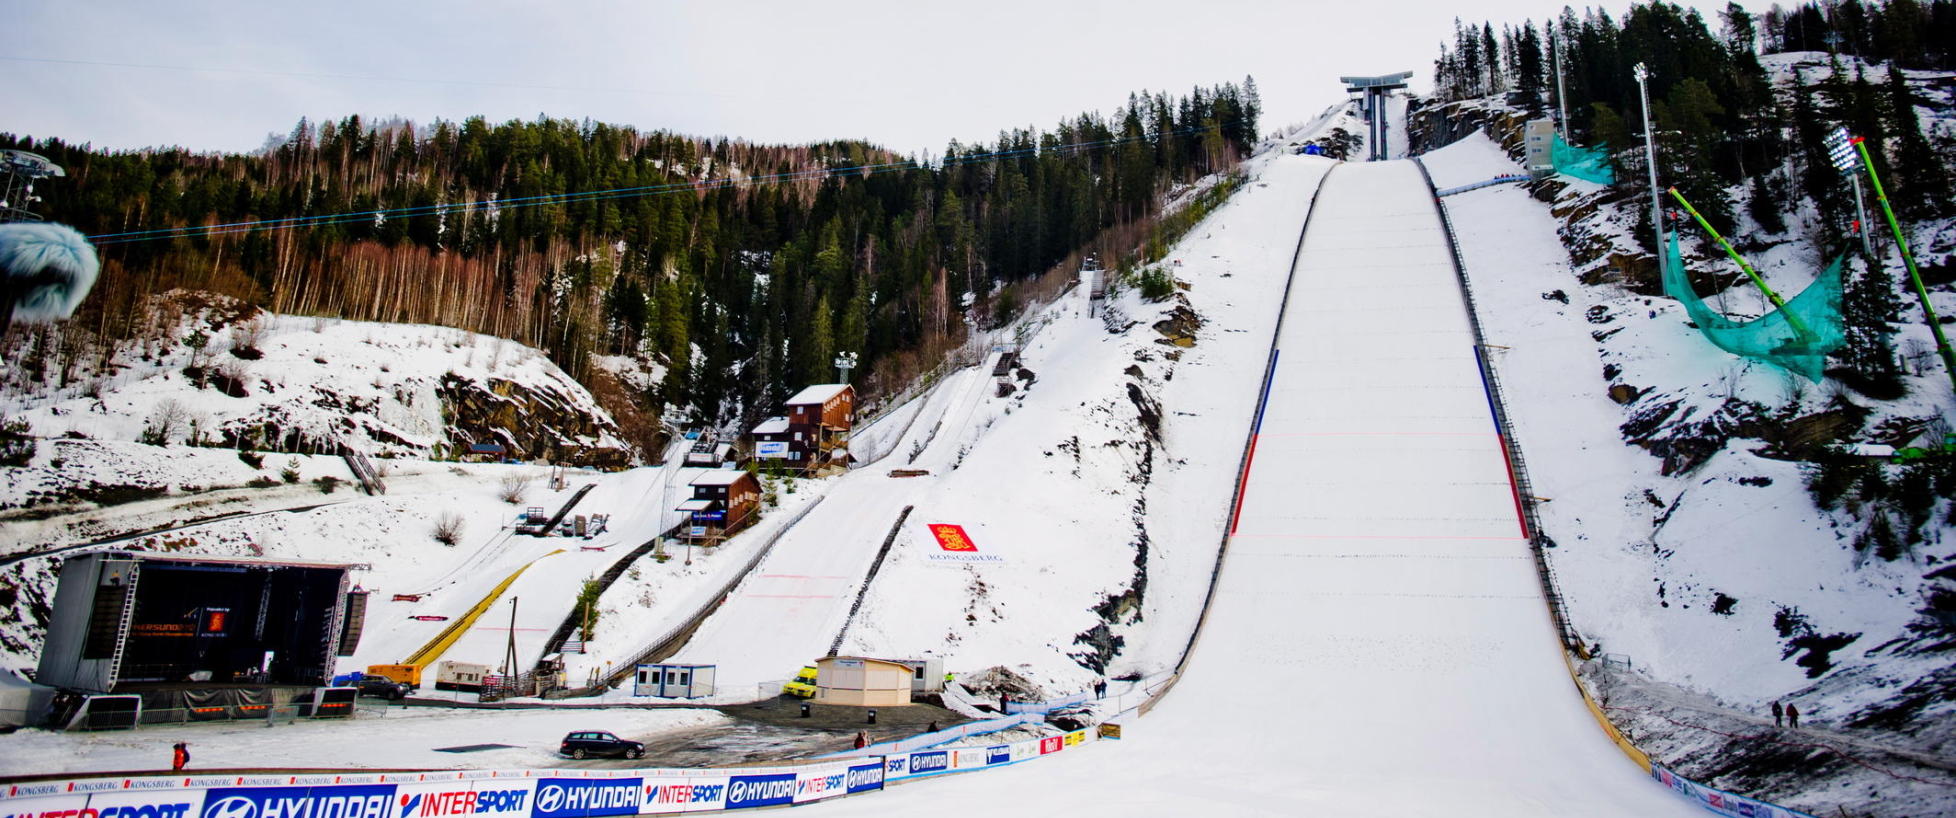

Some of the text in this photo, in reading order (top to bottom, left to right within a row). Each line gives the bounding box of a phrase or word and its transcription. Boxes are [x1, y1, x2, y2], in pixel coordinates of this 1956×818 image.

[130, 780, 175, 790] KONGSBERG
[190, 778, 231, 787] KONGSBERG
[806, 773, 845, 796] INTERSPORT
[856, 766, 884, 786] HYUNDAI
[17, 784, 59, 796] KONGSBERG
[74, 782, 118, 792] KONGSBERG
[658, 784, 724, 804] INTERSPORT
[746, 780, 796, 801] HYUNDAI
[261, 794, 393, 818] HYUNDAI
[420, 790, 528, 817] INTERSPORT
[565, 785, 641, 810] HYUNDAI
[17, 803, 191, 818] SPORT
